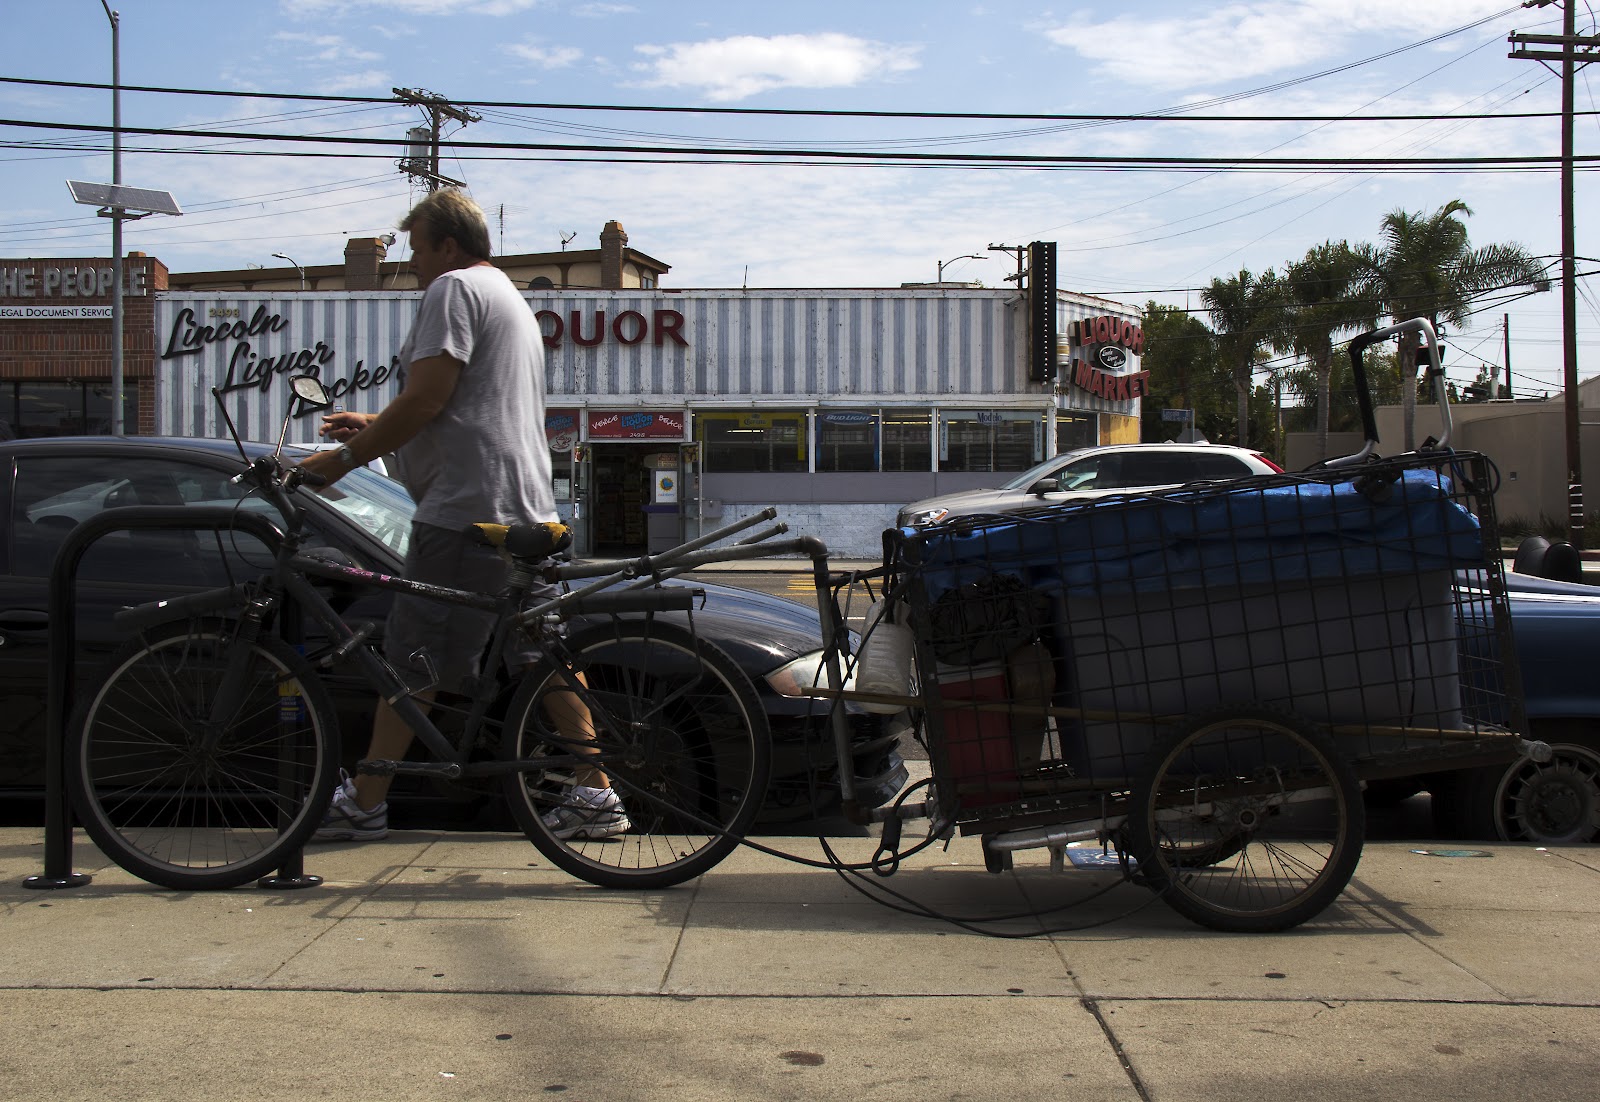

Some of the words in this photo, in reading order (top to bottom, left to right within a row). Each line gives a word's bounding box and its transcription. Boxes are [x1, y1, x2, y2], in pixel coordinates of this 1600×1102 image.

[0, 267, 35, 297] HE
[44, 266, 146, 297] PEOPE
[0, 308, 23, 317] EGAL
[26, 308, 78, 317] DOCUMENT
[81, 308, 113, 317] SERVIC
[161, 304, 289, 360] Lincoln
[208, 307, 241, 318] 2498
[534, 309, 689, 349] QUOR
[1079, 316, 1145, 355] LIQUOR
[220, 341, 335, 394] Liquor
[292, 355, 401, 419] Lcker
[1074, 359, 1151, 401] MARKET
[621, 415, 653, 428] LIQUOR
[977, 412, 1002, 422] Modelo
